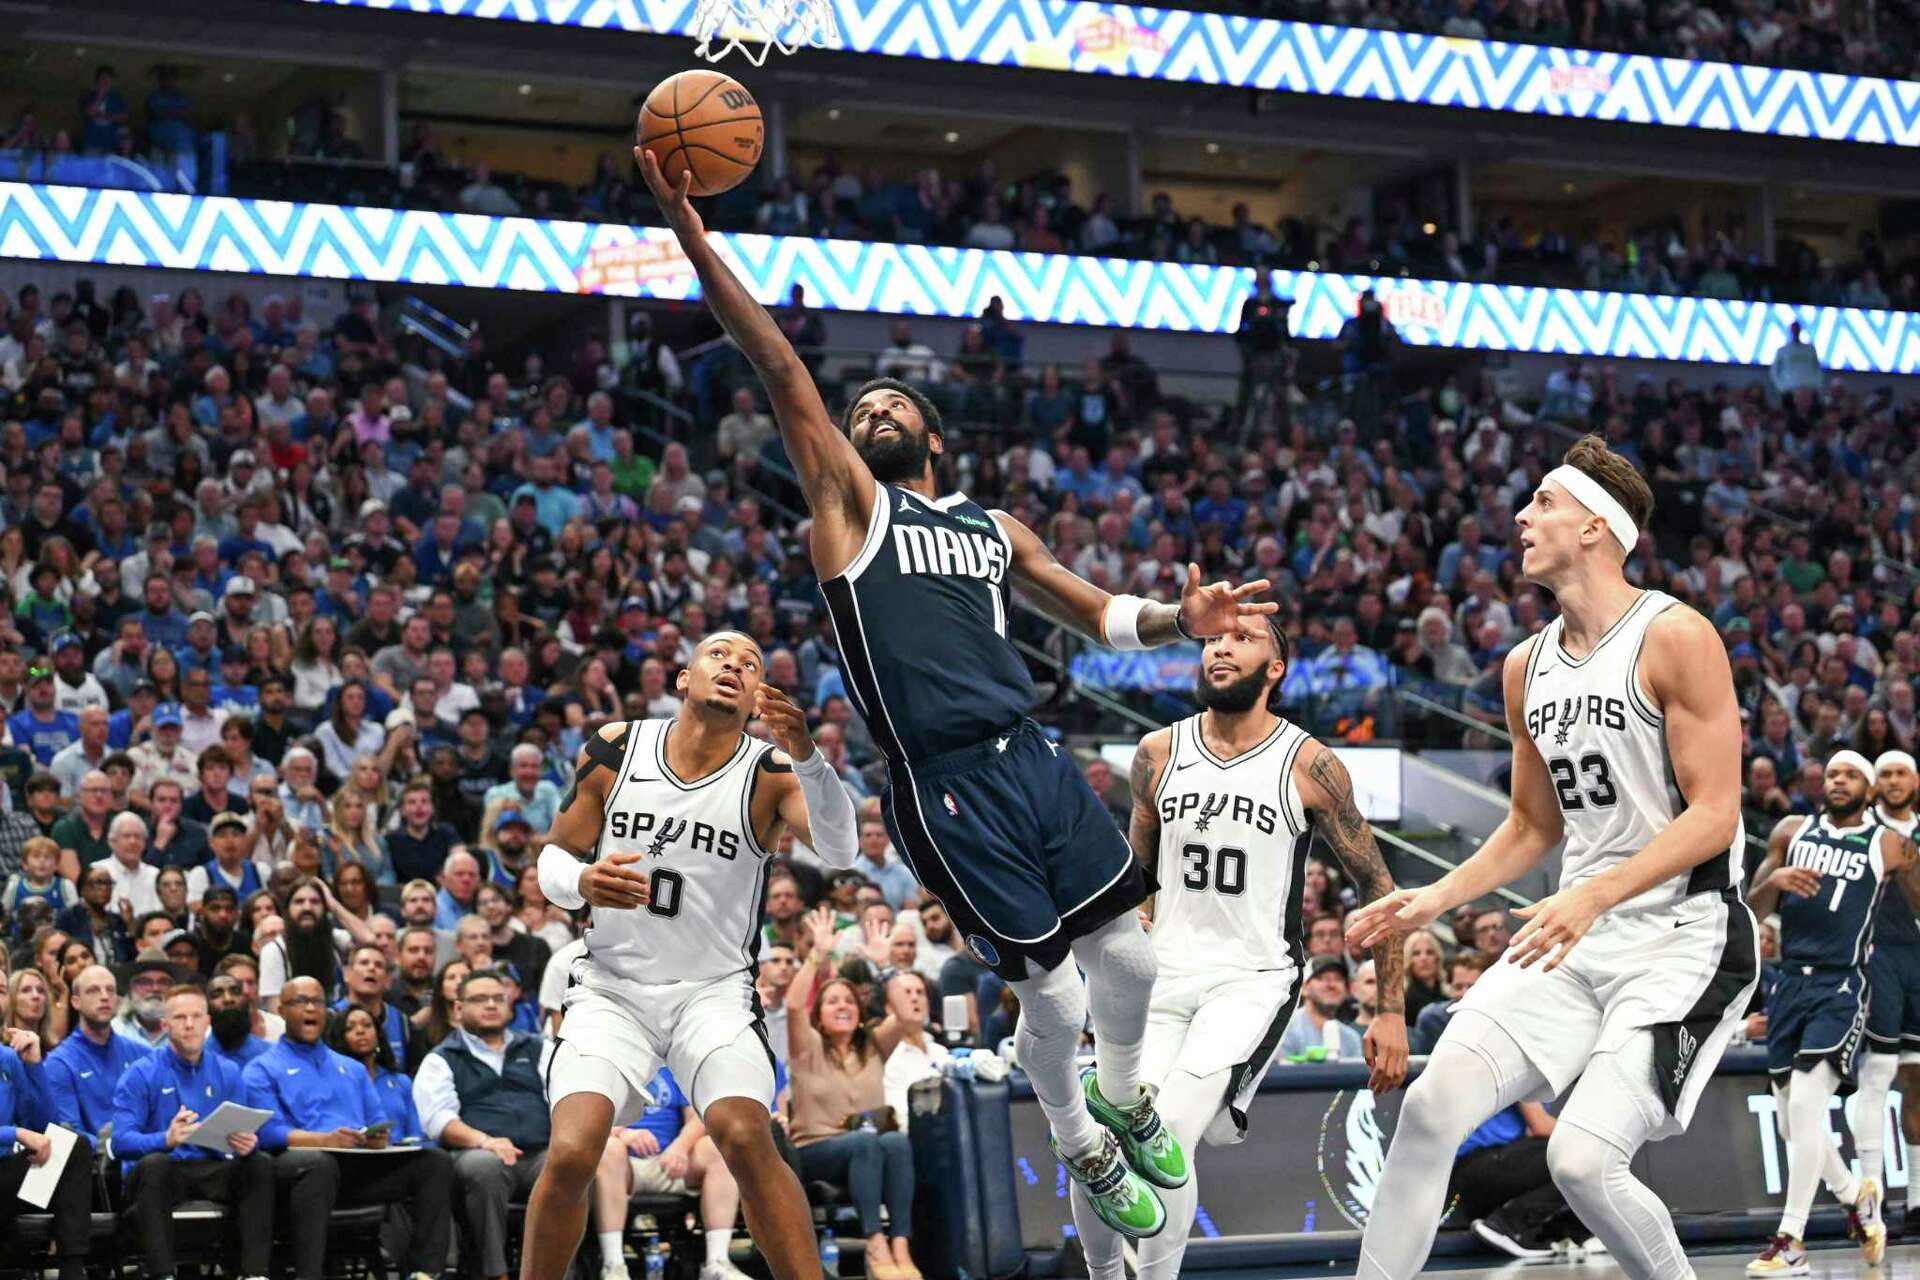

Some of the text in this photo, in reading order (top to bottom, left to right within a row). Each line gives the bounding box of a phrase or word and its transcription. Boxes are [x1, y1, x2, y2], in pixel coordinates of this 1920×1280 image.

[1549, 752, 1617, 811] 23
[611, 811, 740, 860] SPURS
[1162, 793, 1277, 834] SPURS
[646, 867, 686, 919] 0
[1182, 842, 1247, 897] 30
[1828, 878, 1848, 912] 1
